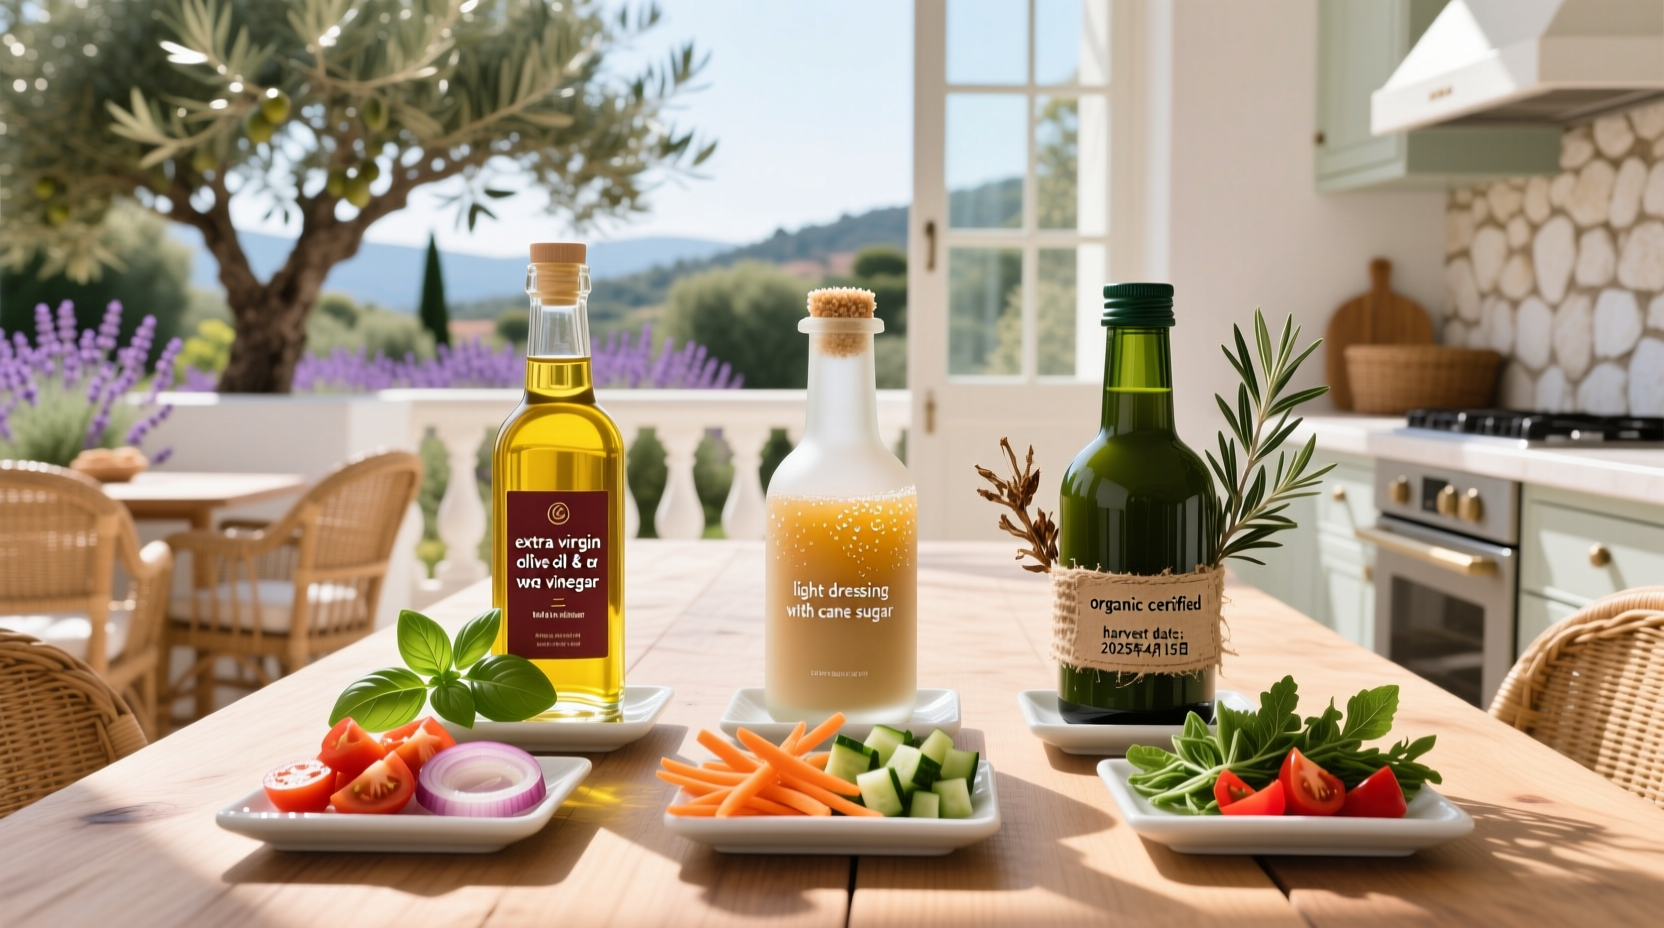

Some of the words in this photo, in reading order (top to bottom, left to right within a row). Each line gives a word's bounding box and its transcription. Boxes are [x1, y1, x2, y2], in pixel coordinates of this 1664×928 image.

[515, 536, 554, 549] extra
[558, 534, 601, 552] virgin
[516, 553, 551, 569] olive
[571, 553, 582, 569] &
[545, 575, 600, 592] vinegar
[793, 580, 825, 600] light
[828, 581, 889, 601] dressing
[786, 602, 814, 618] with
[817, 606, 852, 619] cane
[855, 606, 894, 623] sugar
[1090, 596, 1143, 614] organic
[1103, 625, 1148, 640] harvest
